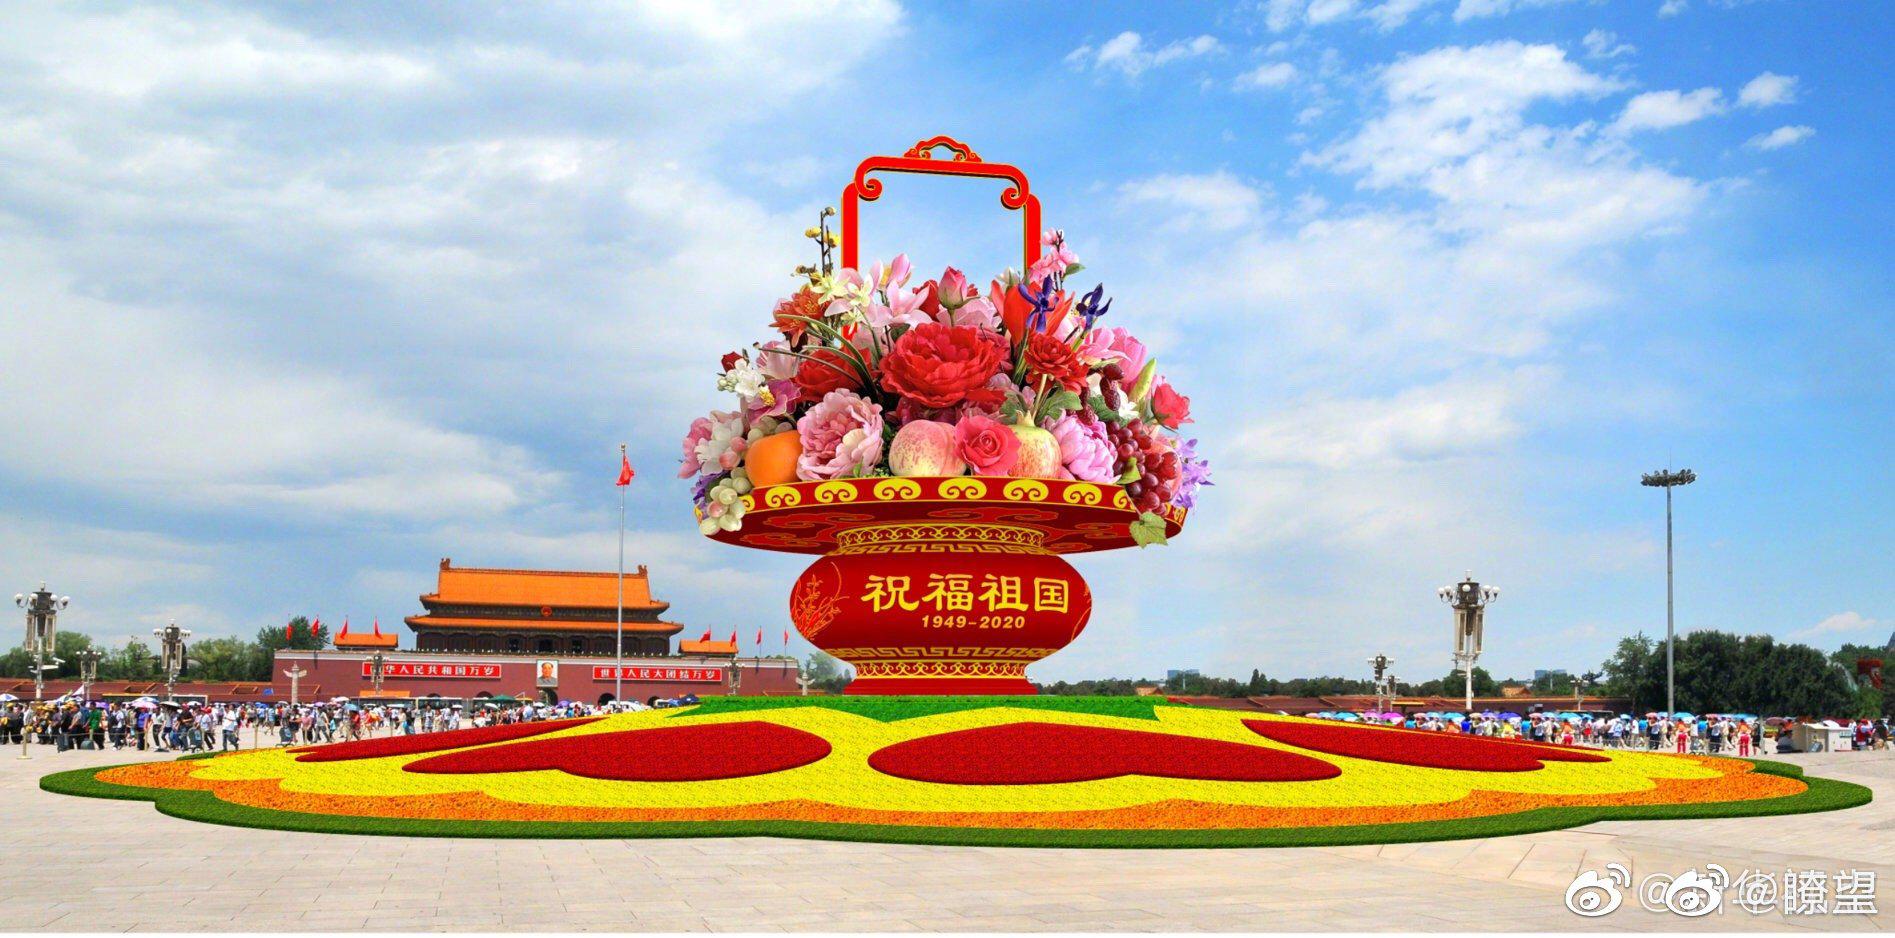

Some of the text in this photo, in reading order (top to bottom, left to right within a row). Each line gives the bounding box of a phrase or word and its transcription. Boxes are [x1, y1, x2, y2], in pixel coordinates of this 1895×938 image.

[861, 573, 1069, 613] 祝福祖国
[921, 615, 1026, 629] 1949-2020
[370, 664, 494, 676] 华人民共和国万岁
